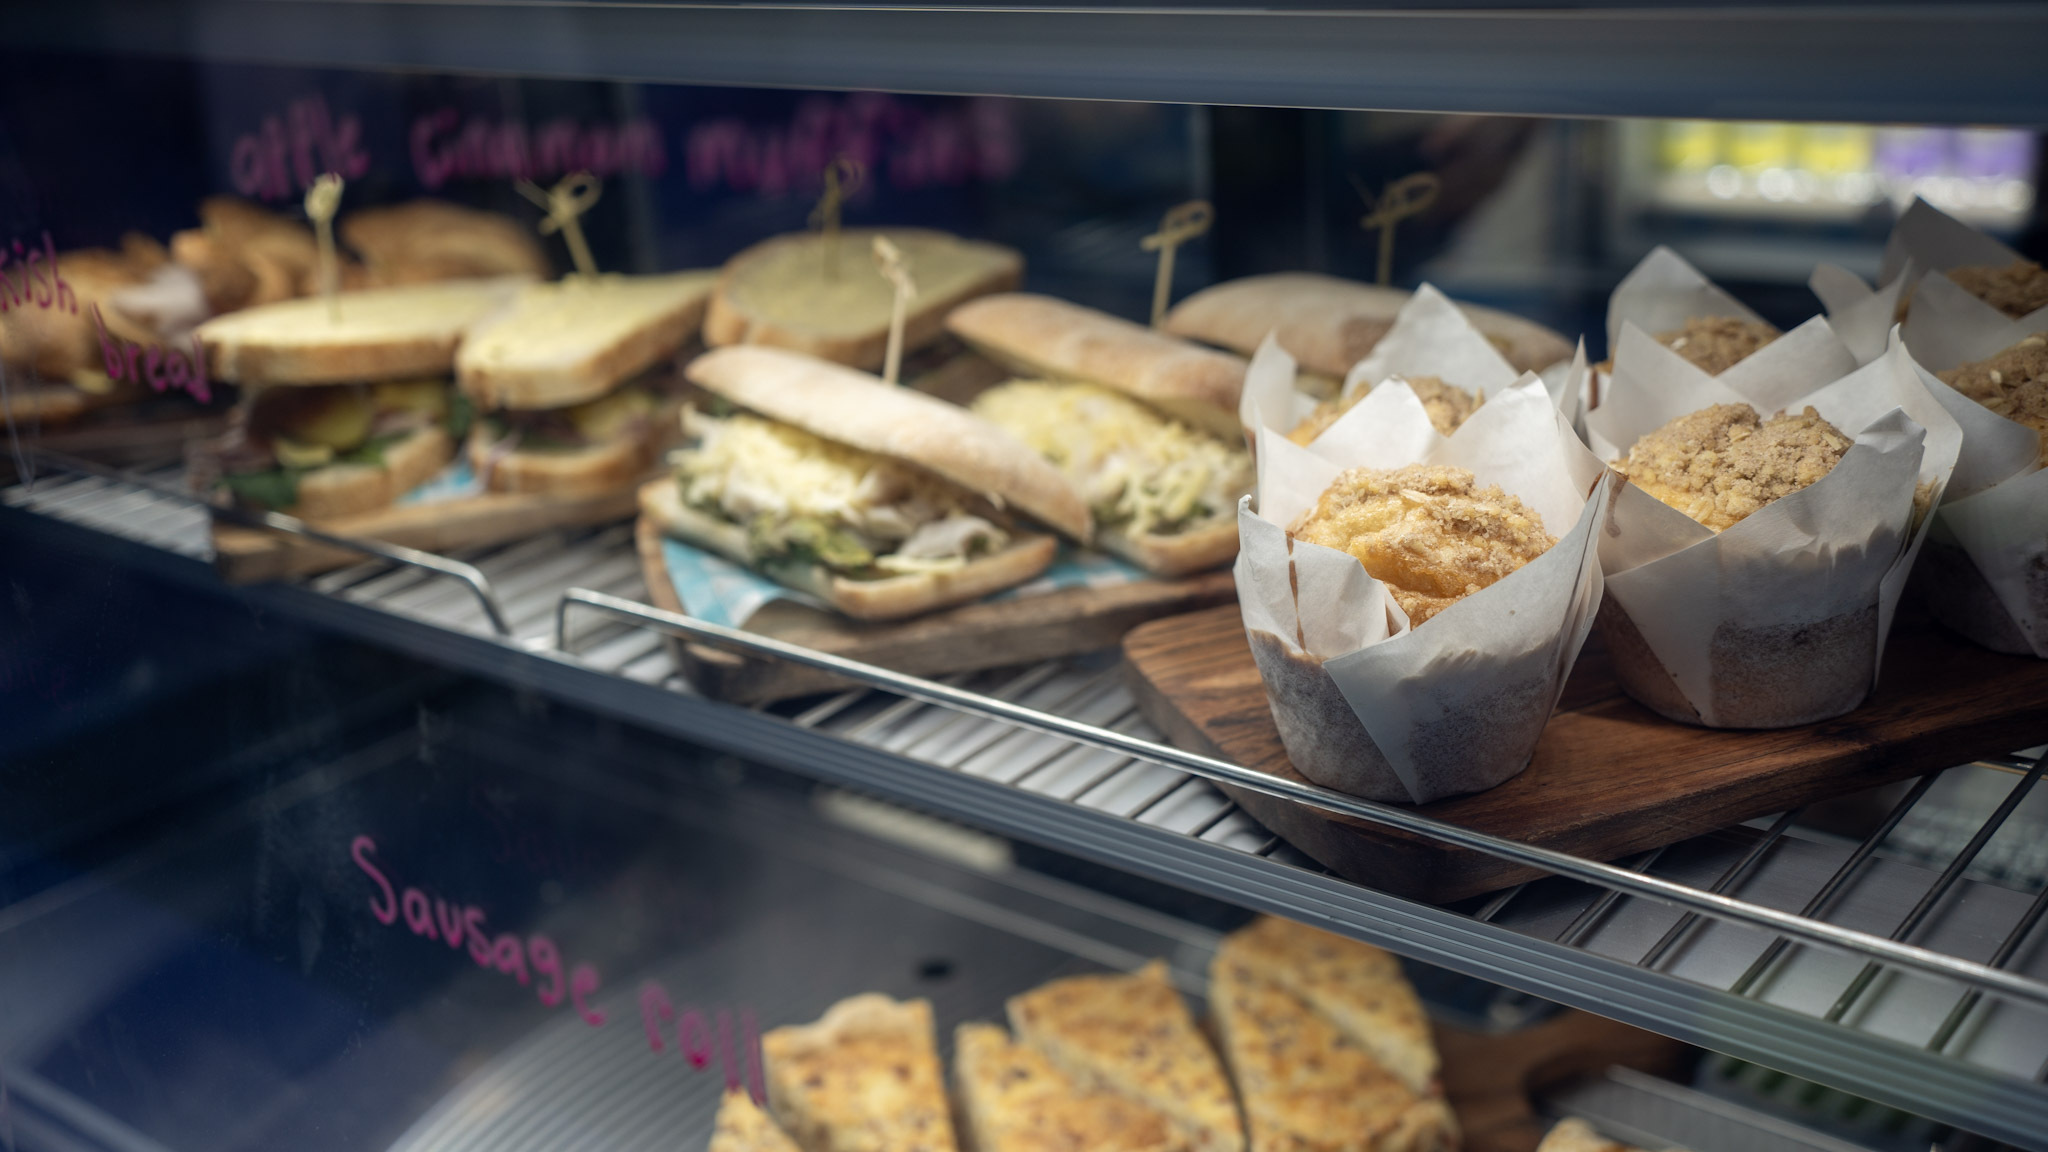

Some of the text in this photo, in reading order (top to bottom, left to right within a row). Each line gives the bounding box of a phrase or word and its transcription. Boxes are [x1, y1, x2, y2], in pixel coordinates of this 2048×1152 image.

[90, 301, 212, 404] bread
[351, 835, 767, 1108] Sausage roll
